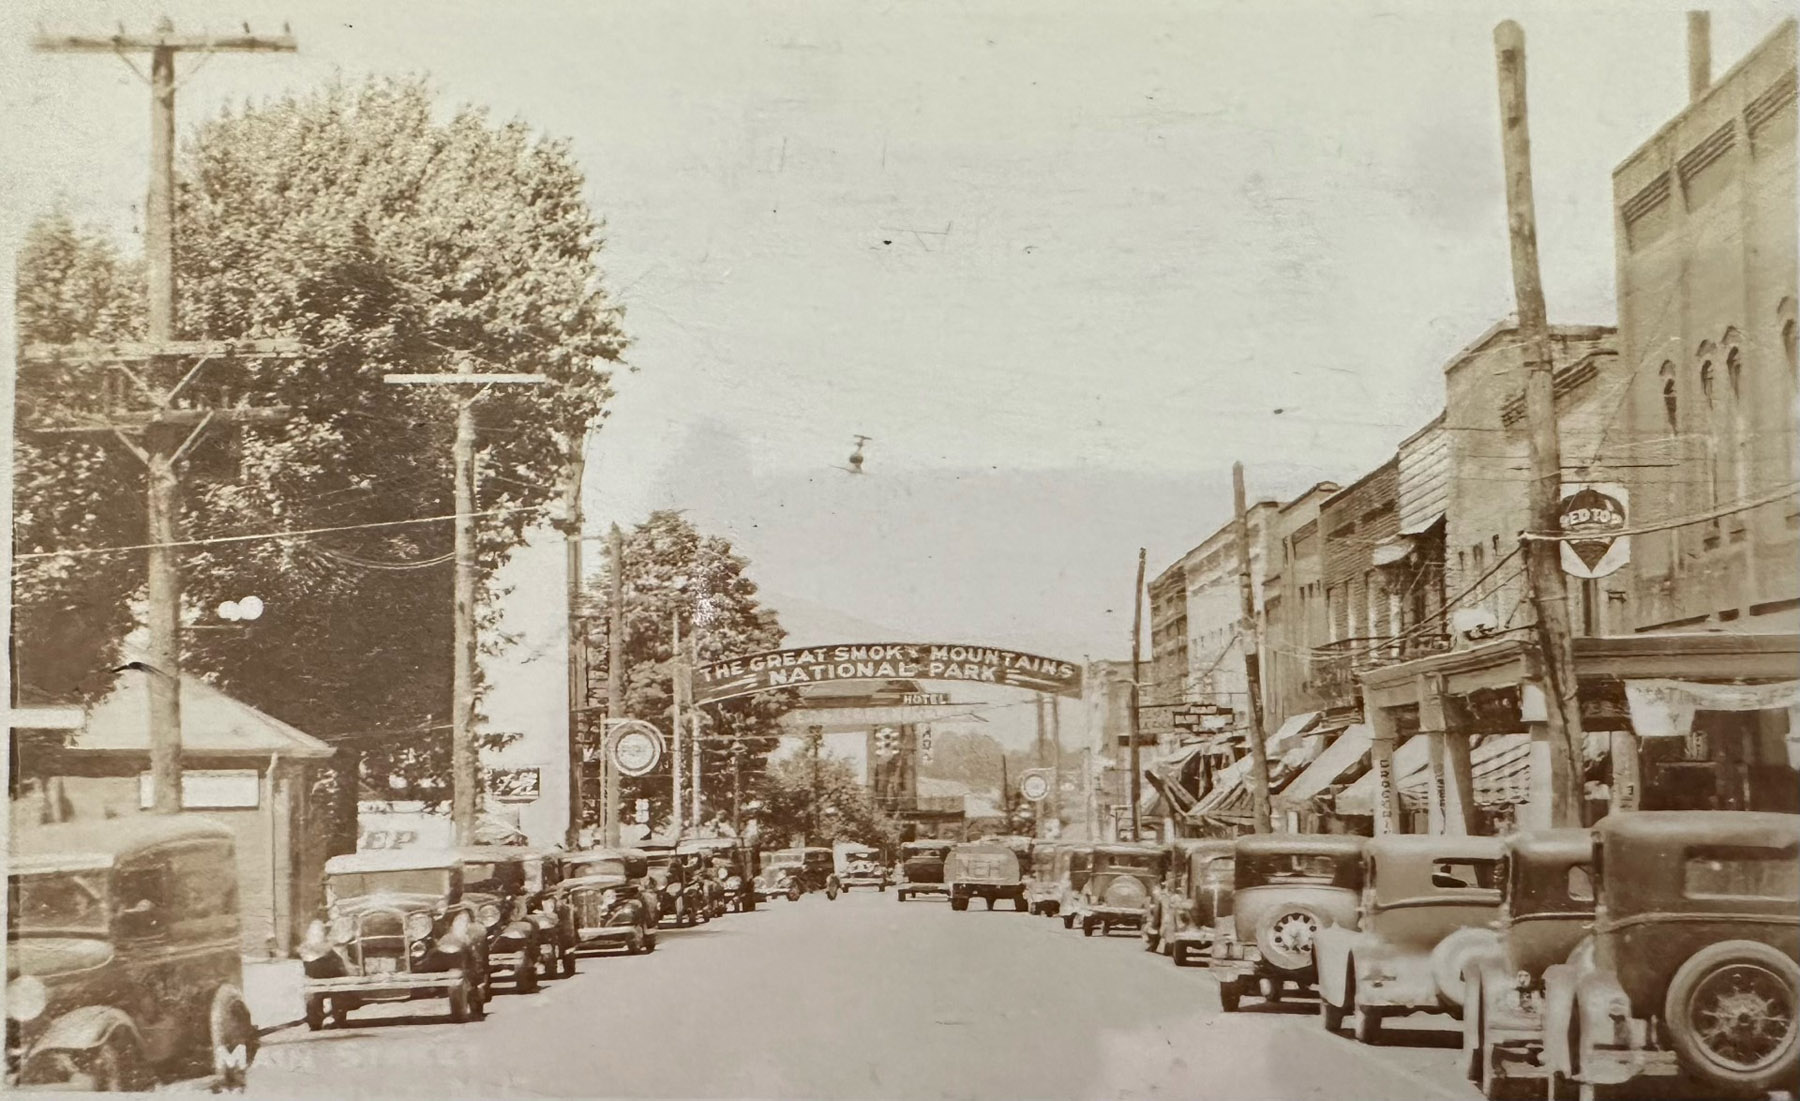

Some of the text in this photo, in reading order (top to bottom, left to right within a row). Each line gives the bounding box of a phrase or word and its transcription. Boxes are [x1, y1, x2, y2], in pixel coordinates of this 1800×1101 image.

[699, 661, 744, 682] THE
[751, 649, 827, 671] GREAT
[930, 647, 1075, 678] MOUNTAINS
[769, 662, 998, 685] NATIONAL PARK
[903, 694, 947, 705] HOTEL
